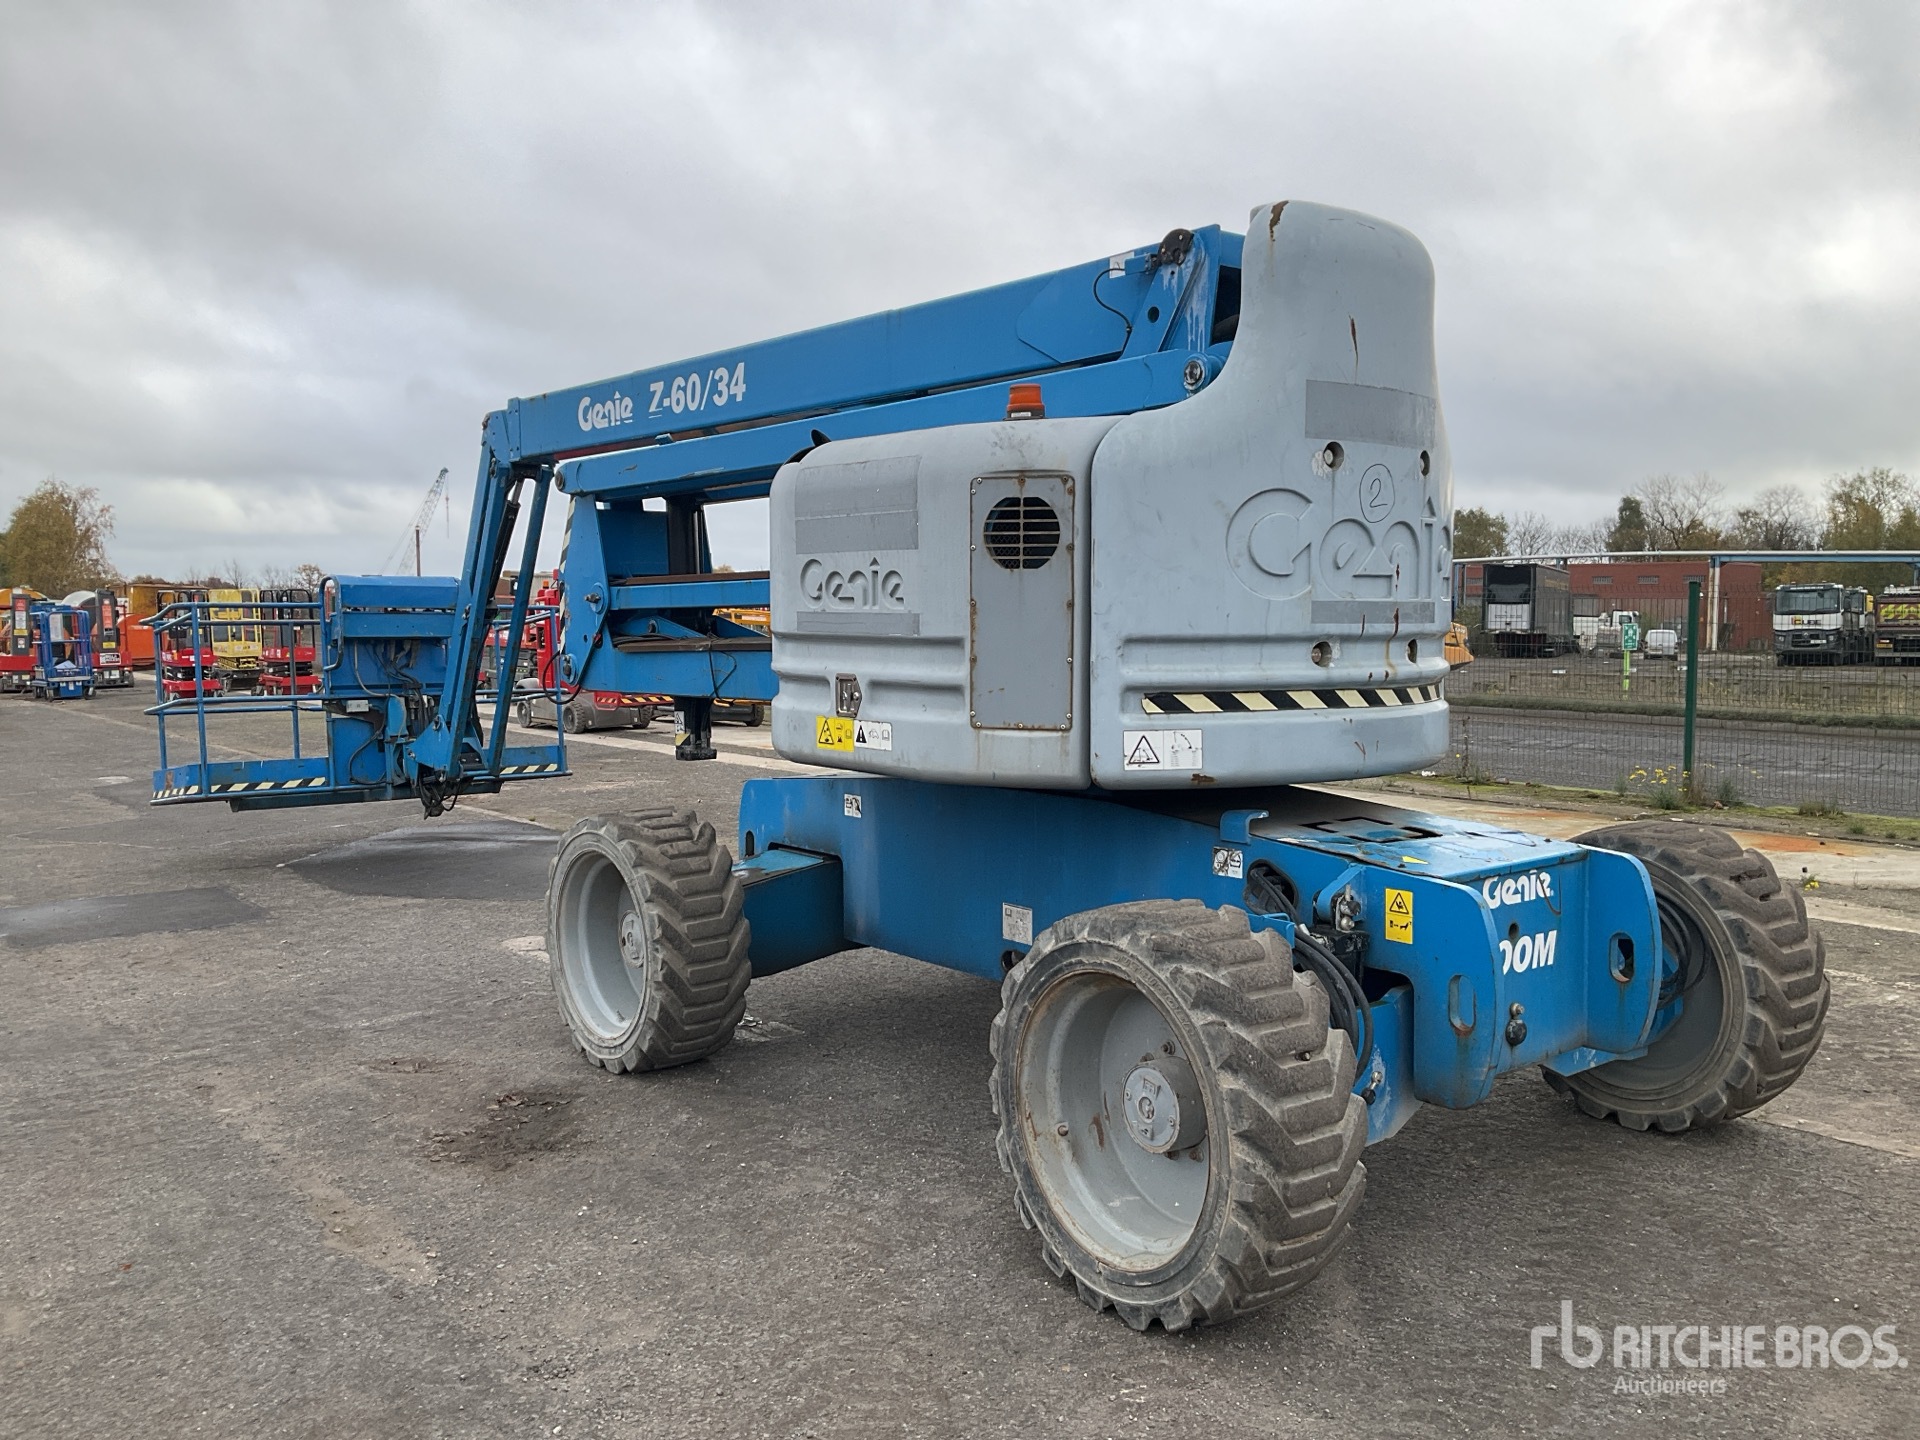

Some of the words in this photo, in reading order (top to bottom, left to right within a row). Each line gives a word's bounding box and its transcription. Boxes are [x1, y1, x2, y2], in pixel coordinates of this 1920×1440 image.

[578, 391, 633, 432] Genie
[649, 362, 746, 416] Z-60/34
[1369, 478, 1388, 507] 2
[800, 557, 905, 610] Genie
[1482, 869, 1552, 910] Genie
[1499, 930, 1557, 975] OOM
